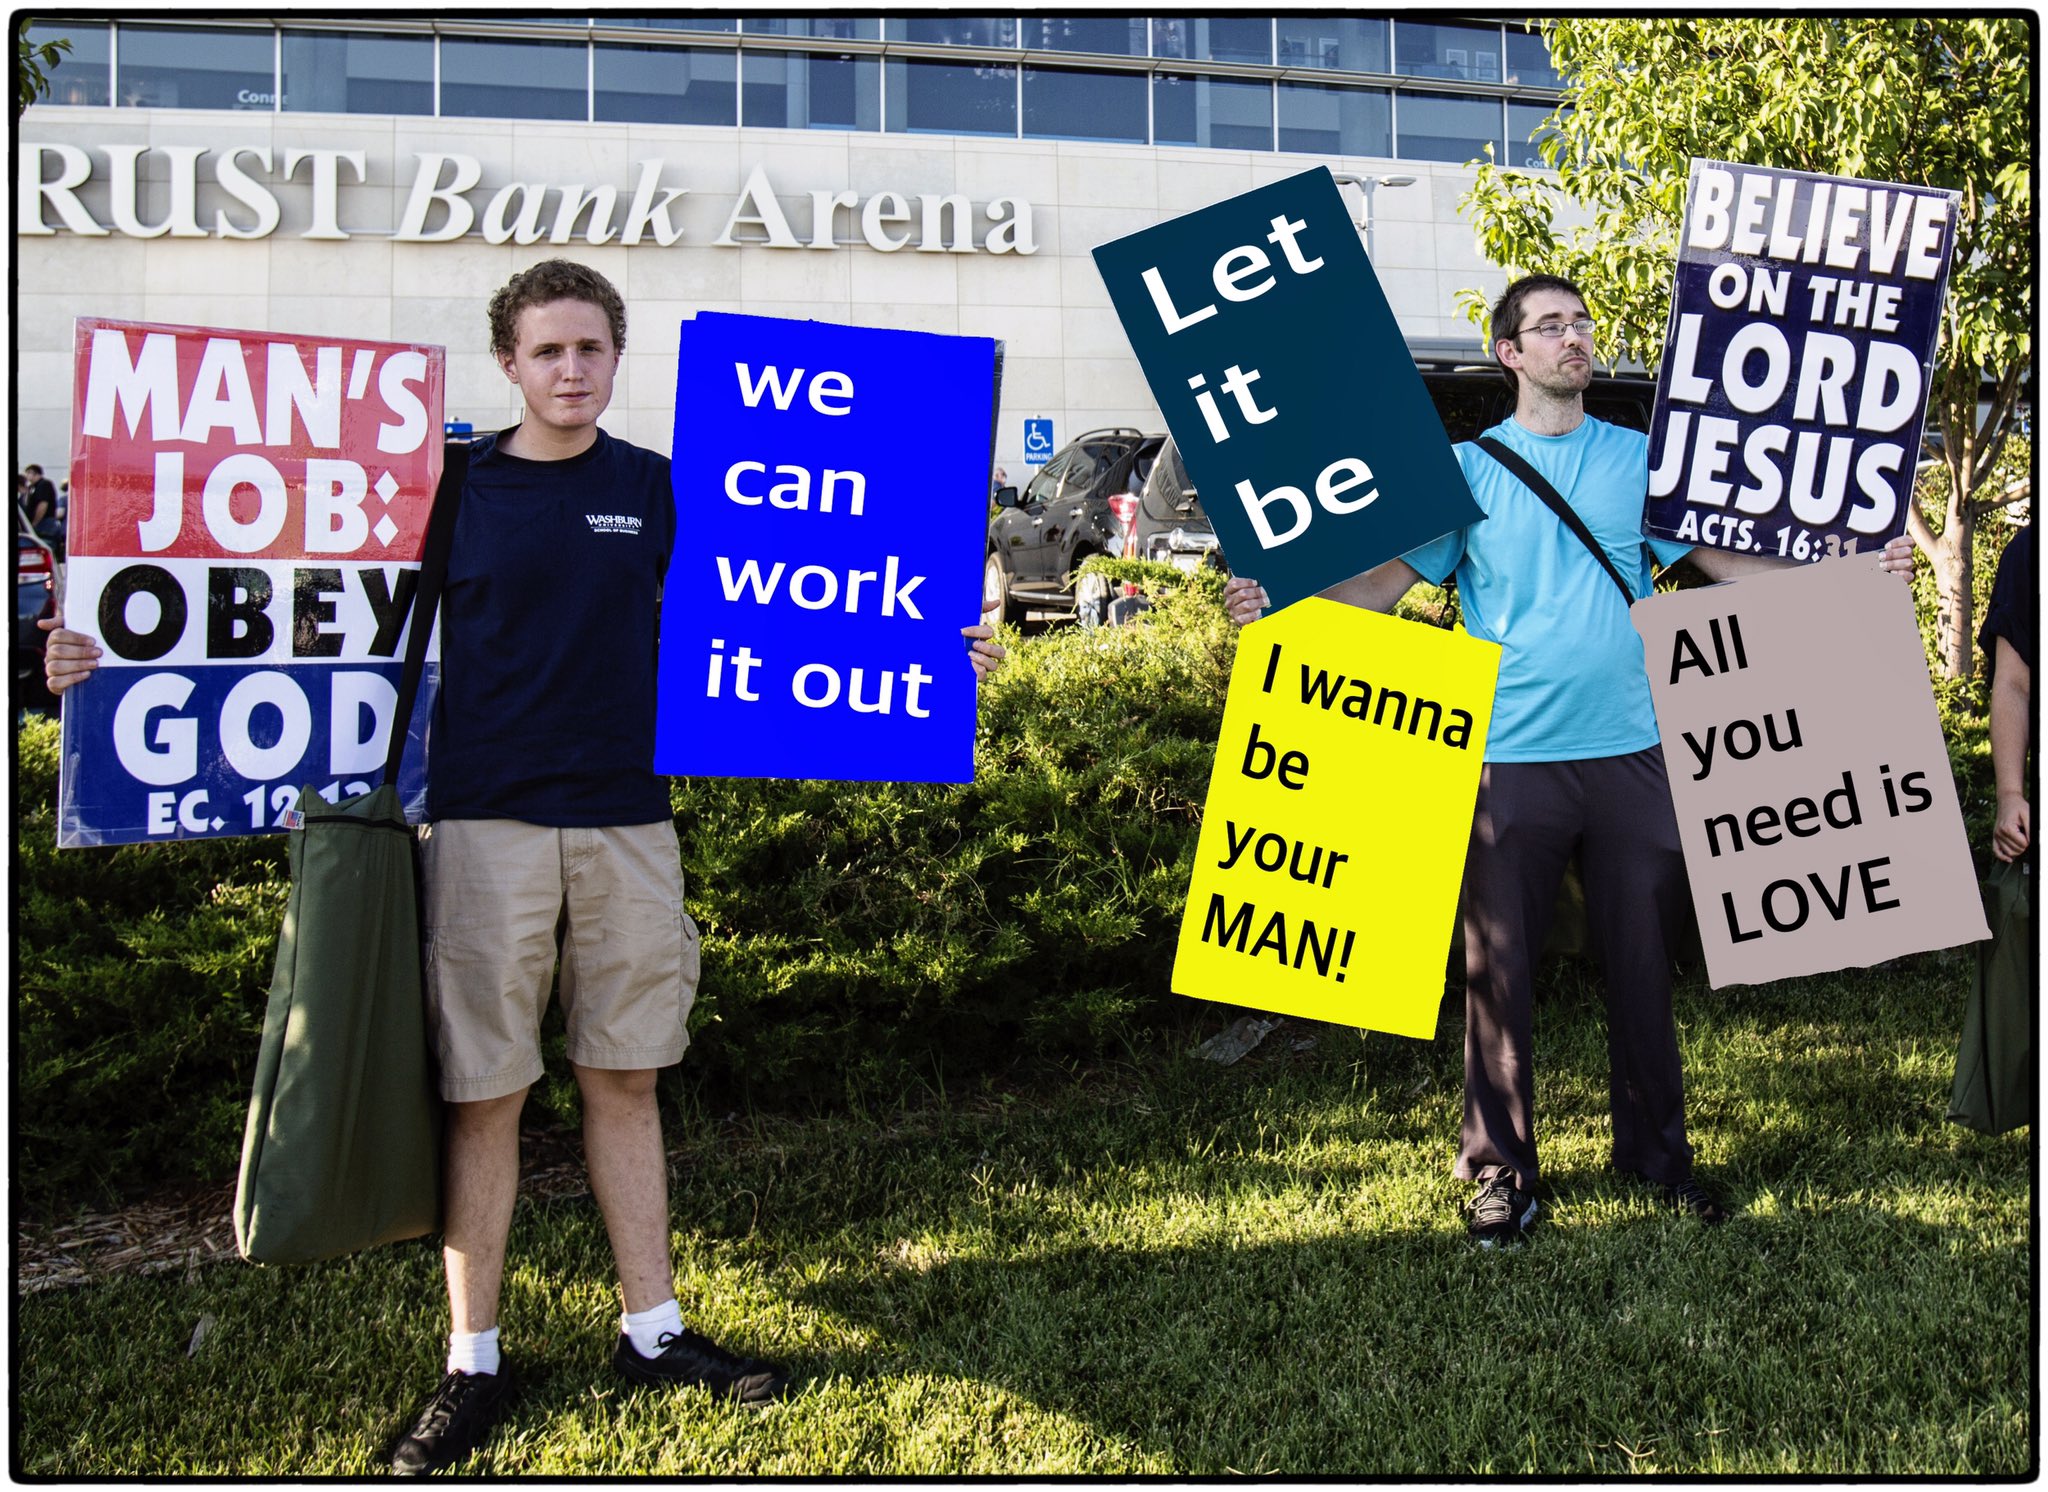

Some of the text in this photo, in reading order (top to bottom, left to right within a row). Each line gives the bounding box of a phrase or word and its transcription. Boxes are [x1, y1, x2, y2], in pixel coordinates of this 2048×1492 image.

[19, 142, 1040, 255] RUST Bank Arena
[1688, 168, 1949, 280] BELIEVE
[1141, 214, 1325, 336] Let
[1708, 262, 1902, 333] ON THE
[82, 328, 428, 454] MAN'S
[734, 362, 854, 416] we
[1187, 364, 1279, 444] it
[1668, 313, 1922, 433] LORD
[137, 452, 400, 553] JOB:
[724, 460, 866, 516] can
[1234, 457, 1380, 550] be
[1648, 410, 1905, 534] JESUS
[585, 514, 642, 528] WASHBURN
[1676, 510, 1762, 552] ACTS.
[98, 563, 421, 662] OBEY
[715, 555, 927, 620] work
[706, 638, 933, 719] it out
[1669, 613, 1749, 686] All
[113, 670, 399, 787] GOD
[1262, 643, 1473, 750] I wanna
[1241, 723, 1309, 791] be
[1680, 708, 1803, 782] you
[147, 789, 226, 835] EC.
[1217, 820, 1349, 889] your
[1703, 763, 1933, 858] need is
[1201, 892, 1356, 983] MAN!
[1721, 856, 1901, 945] LOVE
